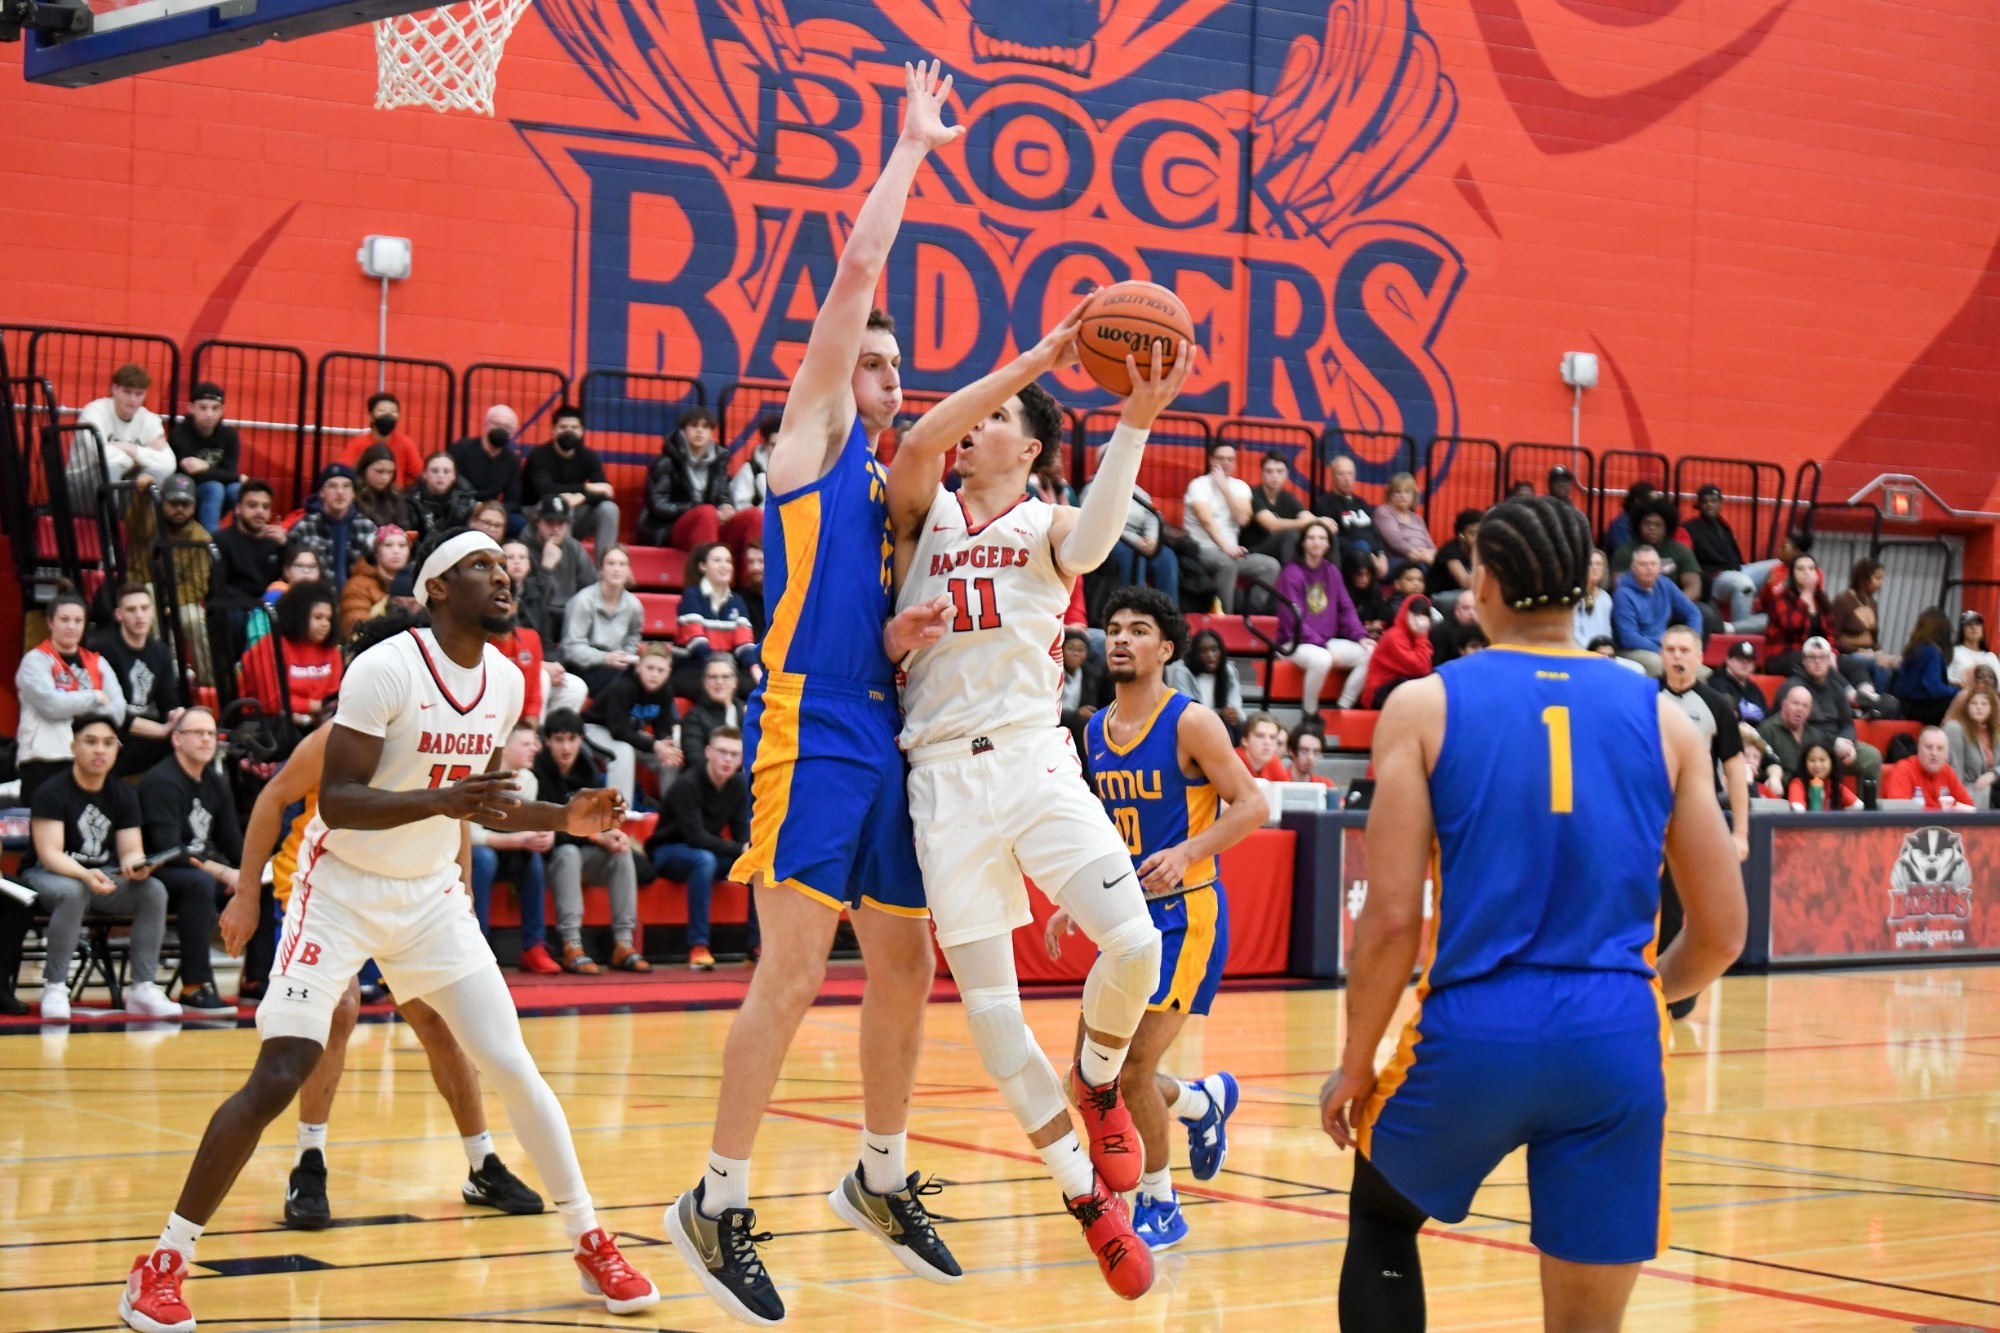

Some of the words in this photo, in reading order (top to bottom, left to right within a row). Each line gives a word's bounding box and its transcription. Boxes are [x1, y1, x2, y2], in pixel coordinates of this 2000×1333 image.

[929, 545, 1030, 577] BADGERS
[947, 577, 1002, 632] 11
[417, 731, 493, 755] BADGERS
[1541, 705, 1573, 813] 1
[1095, 769, 1163, 800] TMU
[1895, 927, 1964, 949] gobadgers.ca
